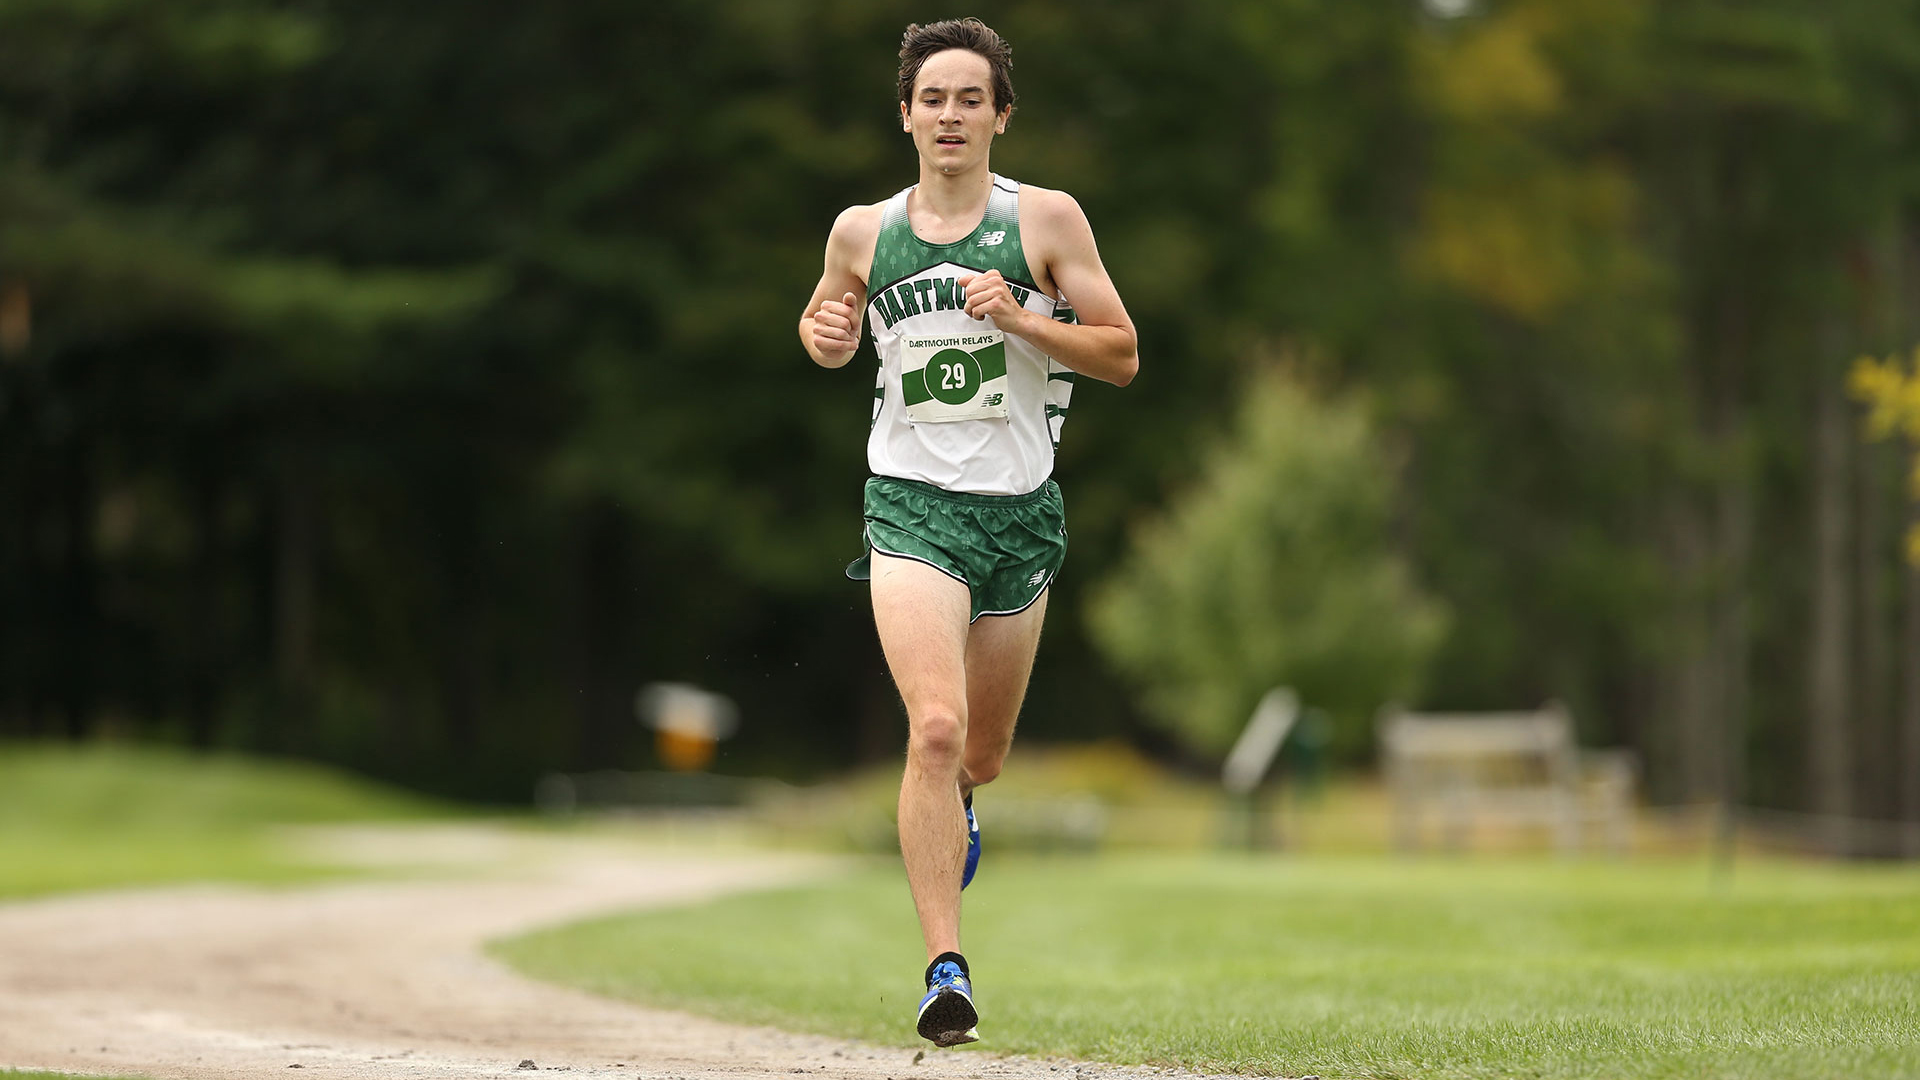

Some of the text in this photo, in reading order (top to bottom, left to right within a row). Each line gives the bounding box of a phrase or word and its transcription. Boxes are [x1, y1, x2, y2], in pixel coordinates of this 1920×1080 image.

[873, 277, 1030, 330] DARTMOH
[909, 335, 993, 348] DARTMOUTH RELAYS
[939, 362, 966, 390] 29
